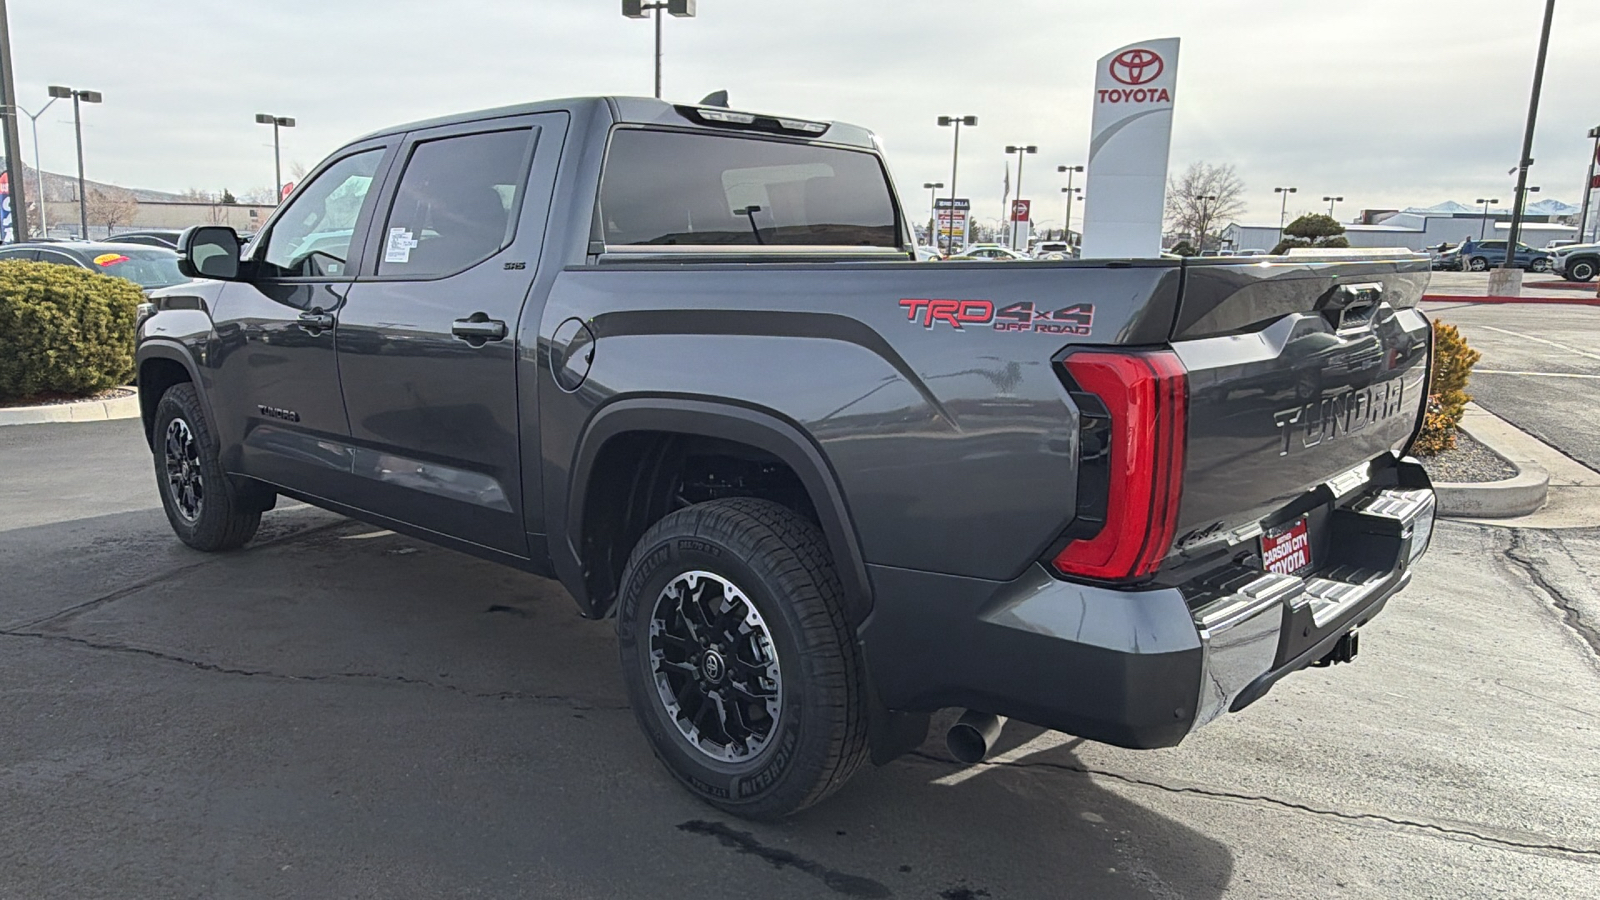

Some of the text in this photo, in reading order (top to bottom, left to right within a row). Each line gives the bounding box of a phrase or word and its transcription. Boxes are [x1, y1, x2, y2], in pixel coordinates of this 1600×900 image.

[1098, 88, 1170, 103] TOYOTA
[503, 261, 526, 270] SR5
[899, 298, 997, 332] TRD
[993, 322, 1092, 336] OFF ROAD
[257, 404, 300, 422] TUNDRA
[1273, 376, 1403, 457] TUNDRA
[1263, 540, 1293, 566] CARSON
[1292, 532, 1308, 551] CITY
[1270, 549, 1306, 575] TOYOTA
[625, 546, 668, 618] MICHELIN
[741, 727, 795, 797] MICHELIN
